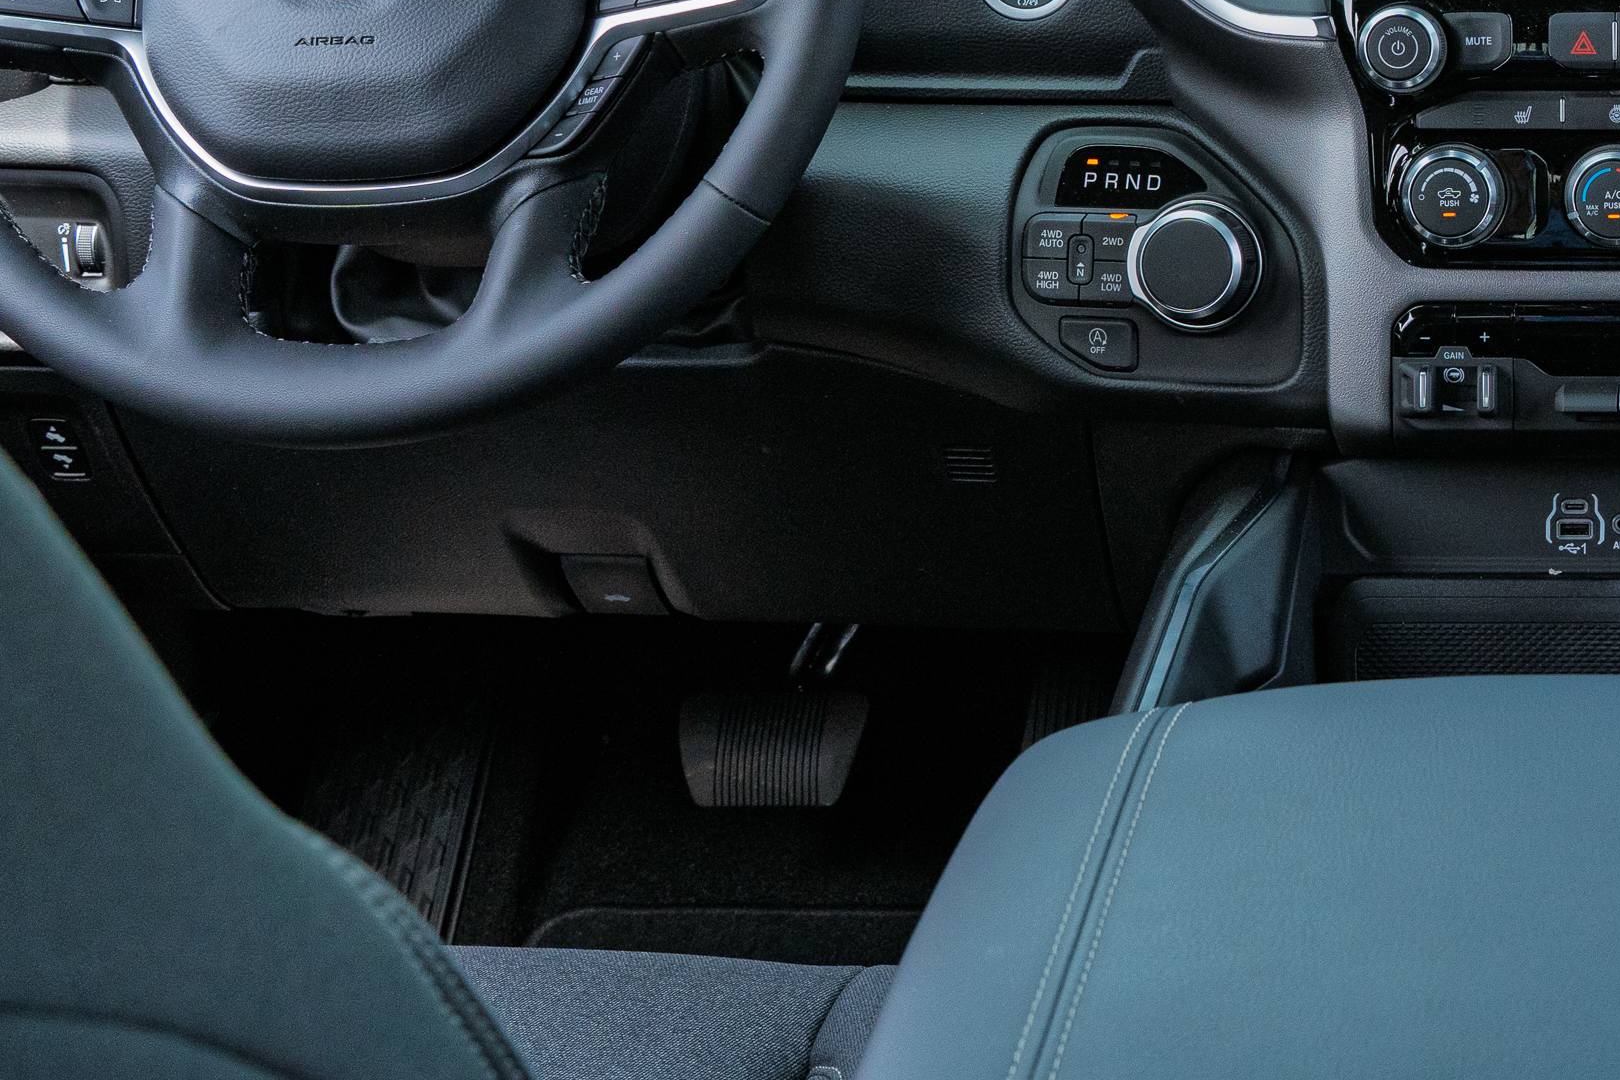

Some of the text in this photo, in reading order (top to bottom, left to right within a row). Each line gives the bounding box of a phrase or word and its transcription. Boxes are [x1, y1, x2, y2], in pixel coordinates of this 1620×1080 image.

[1384, 25, 1413, 38] VOLUME
[293, 35, 376, 47] AIRBAG
[1465, 36, 1493, 46] MUTE
[584, 86, 604, 95] GEAR
[578, 96, 597, 105] LIMIT
[1439, 199, 1460, 208] PUSH
[1041, 229, 1063, 239] 4WD
[1039, 238, 1064, 248] AUTO
[1102, 237, 1124, 246] 2WD
[1038, 271, 1059, 280] 4WD
[1076, 269, 1084, 277] N
[1101, 273, 1122, 282] 4WD
[1036, 280, 1059, 289] HIGH
[1101, 283, 1122, 292] LOW
[1090, 346, 1106, 354] OFF
[1443, 351, 1464, 360] GAIN
[1580, 543, 1587, 555] 1
